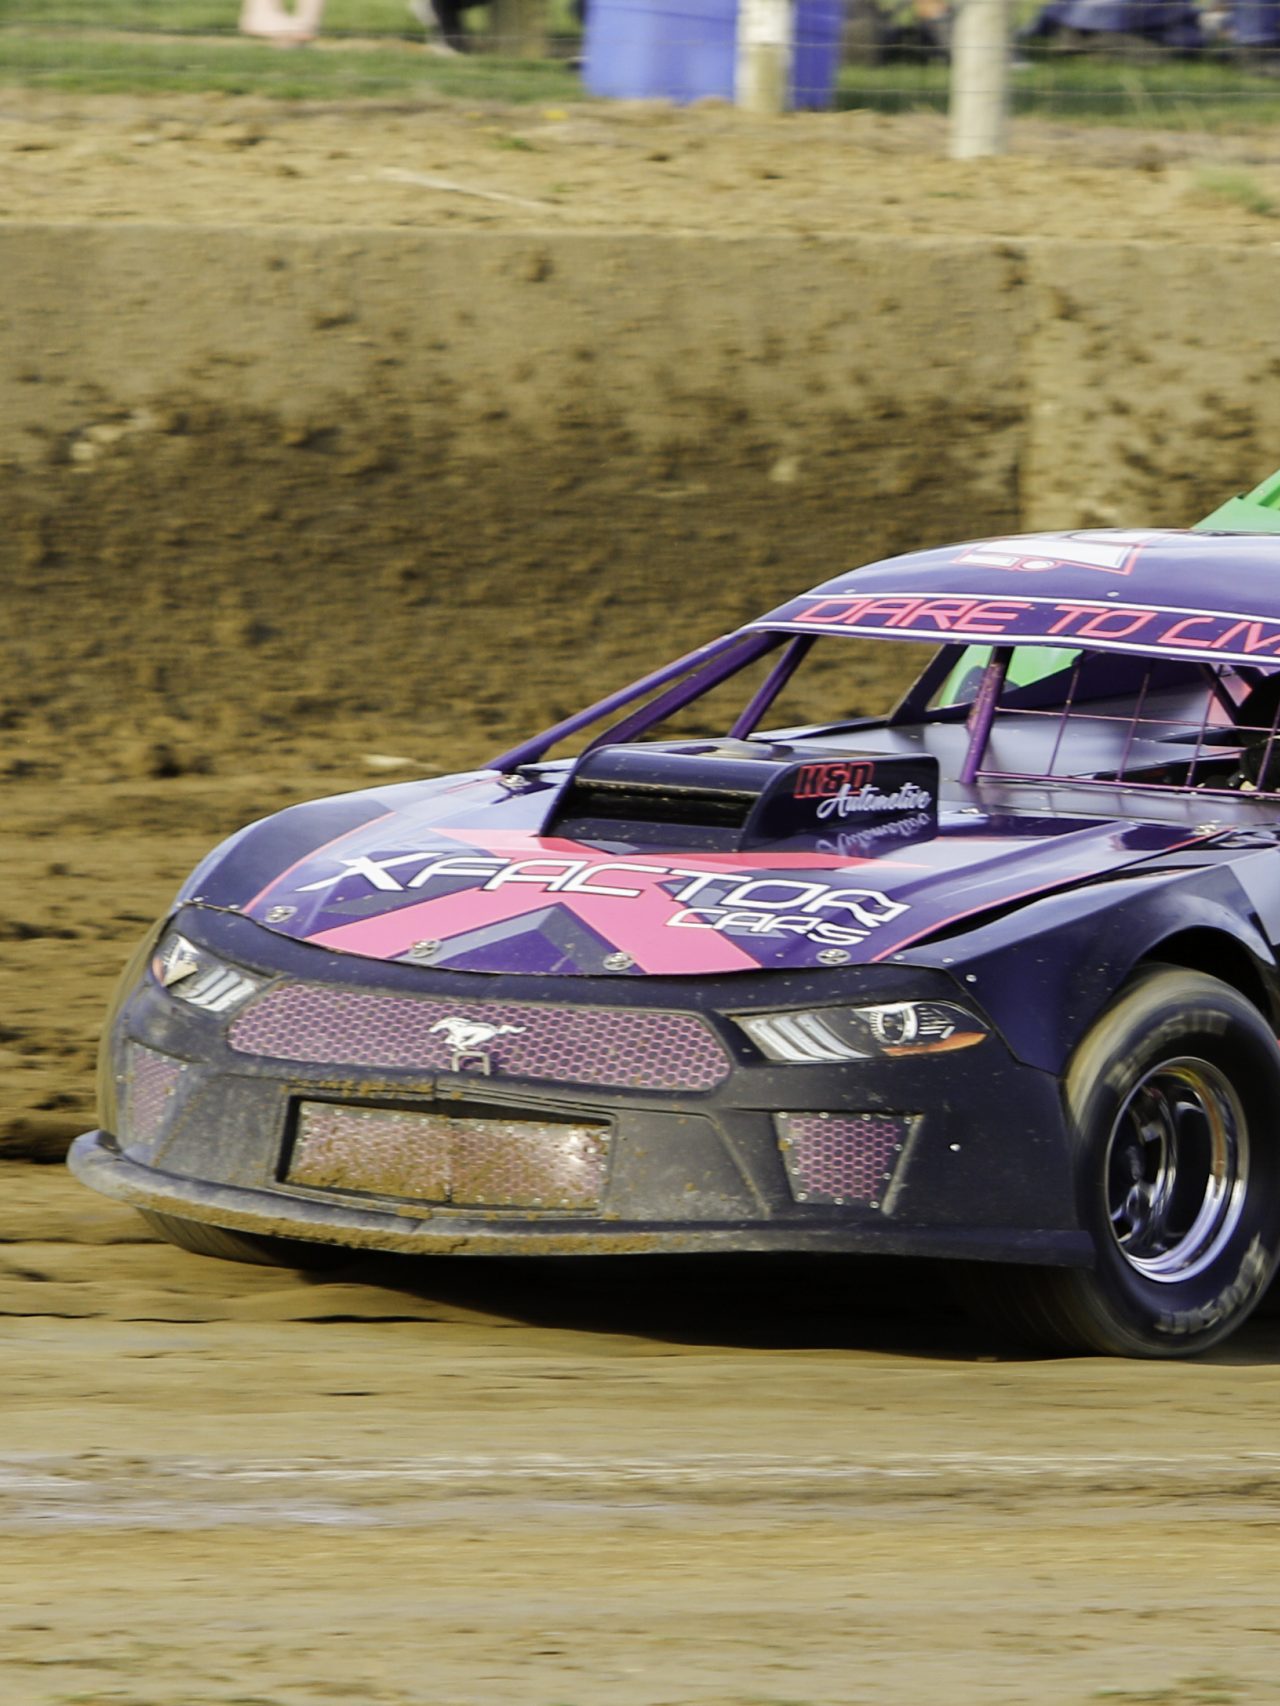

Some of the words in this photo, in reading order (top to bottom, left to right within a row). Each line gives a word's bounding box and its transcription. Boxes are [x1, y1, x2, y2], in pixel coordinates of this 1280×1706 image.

[792, 598, 1034, 633] DARE
[1046, 603, 1158, 639] TO
[816, 781, 932, 818] Automotive
[665, 907, 872, 946] CARS
